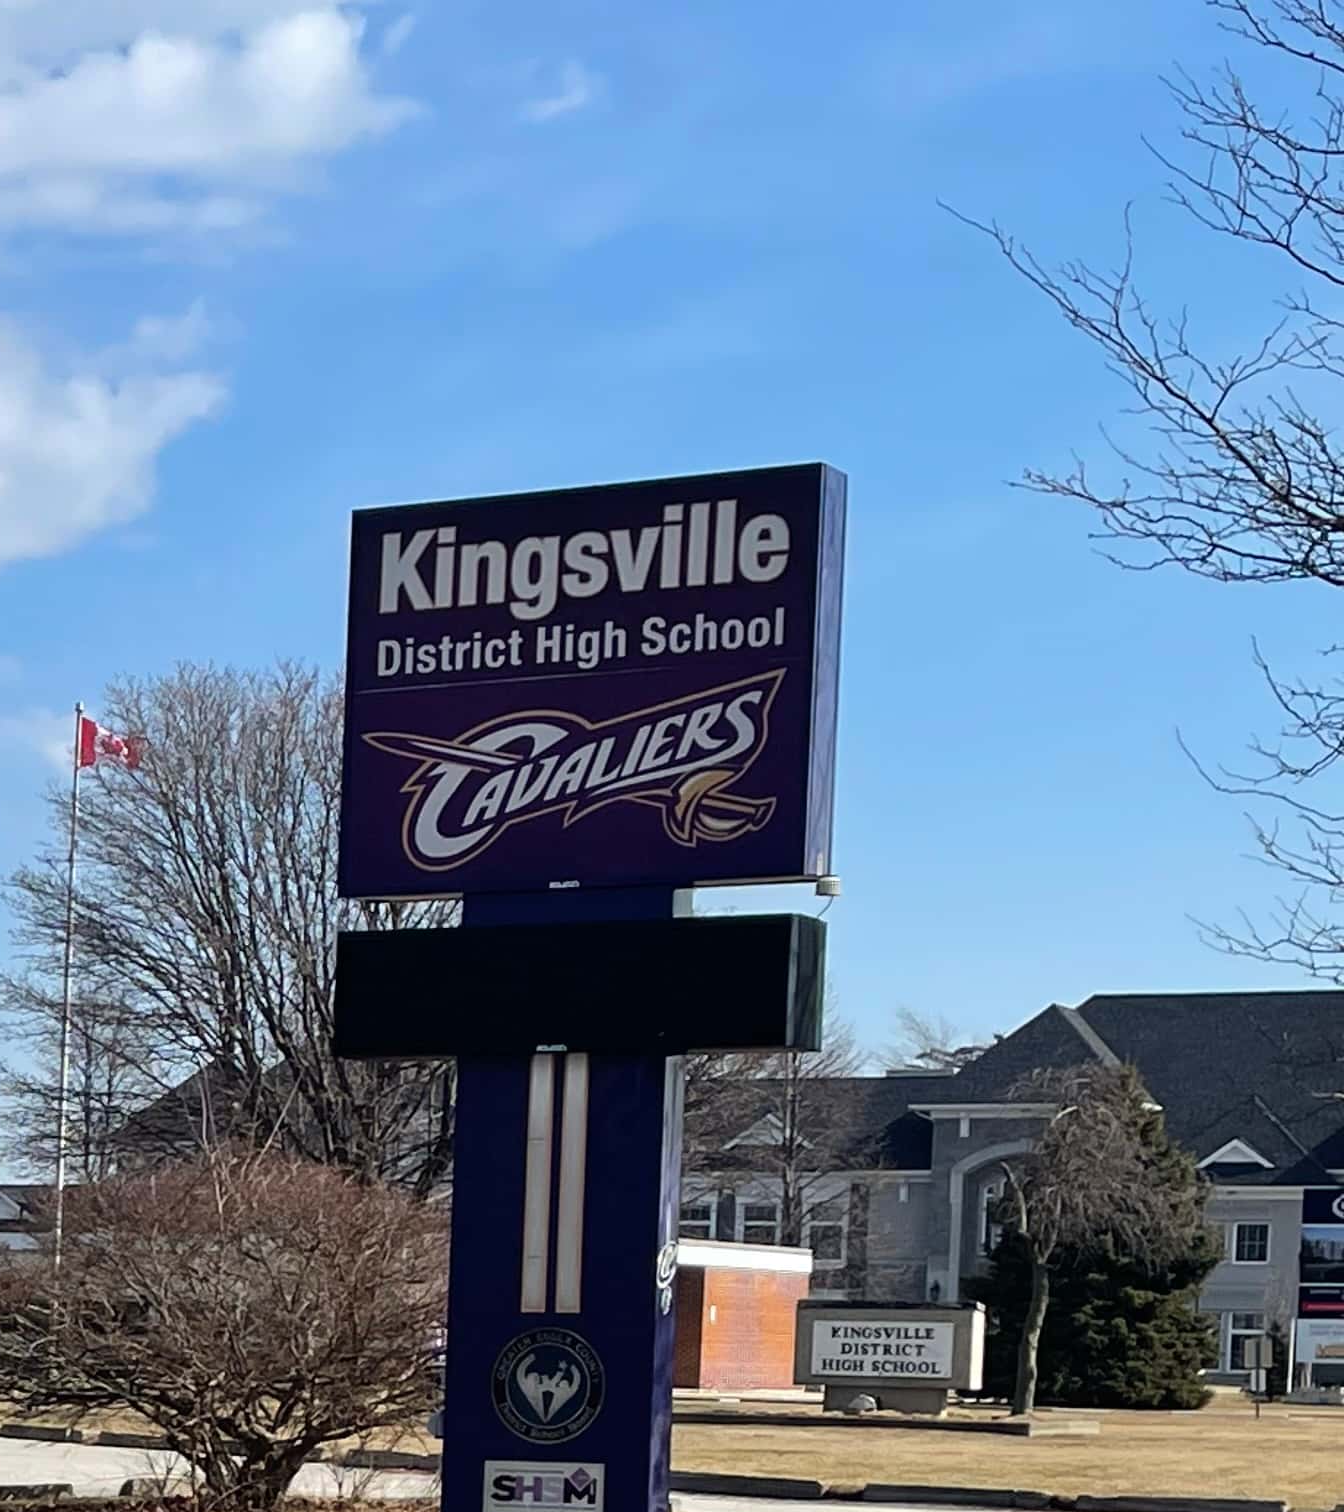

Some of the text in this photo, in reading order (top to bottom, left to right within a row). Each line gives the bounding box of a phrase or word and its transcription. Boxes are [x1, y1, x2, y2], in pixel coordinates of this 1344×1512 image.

[379, 499, 790, 620] Kingsville
[377, 607, 785, 676] District High School
[415, 690, 763, 858] CAVALIERS
[831, 1326, 935, 1340] KINGSVILLE
[840, 1343, 926, 1357] DISTRICT
[821, 1359, 941, 1374] HIGH SCHOOL
